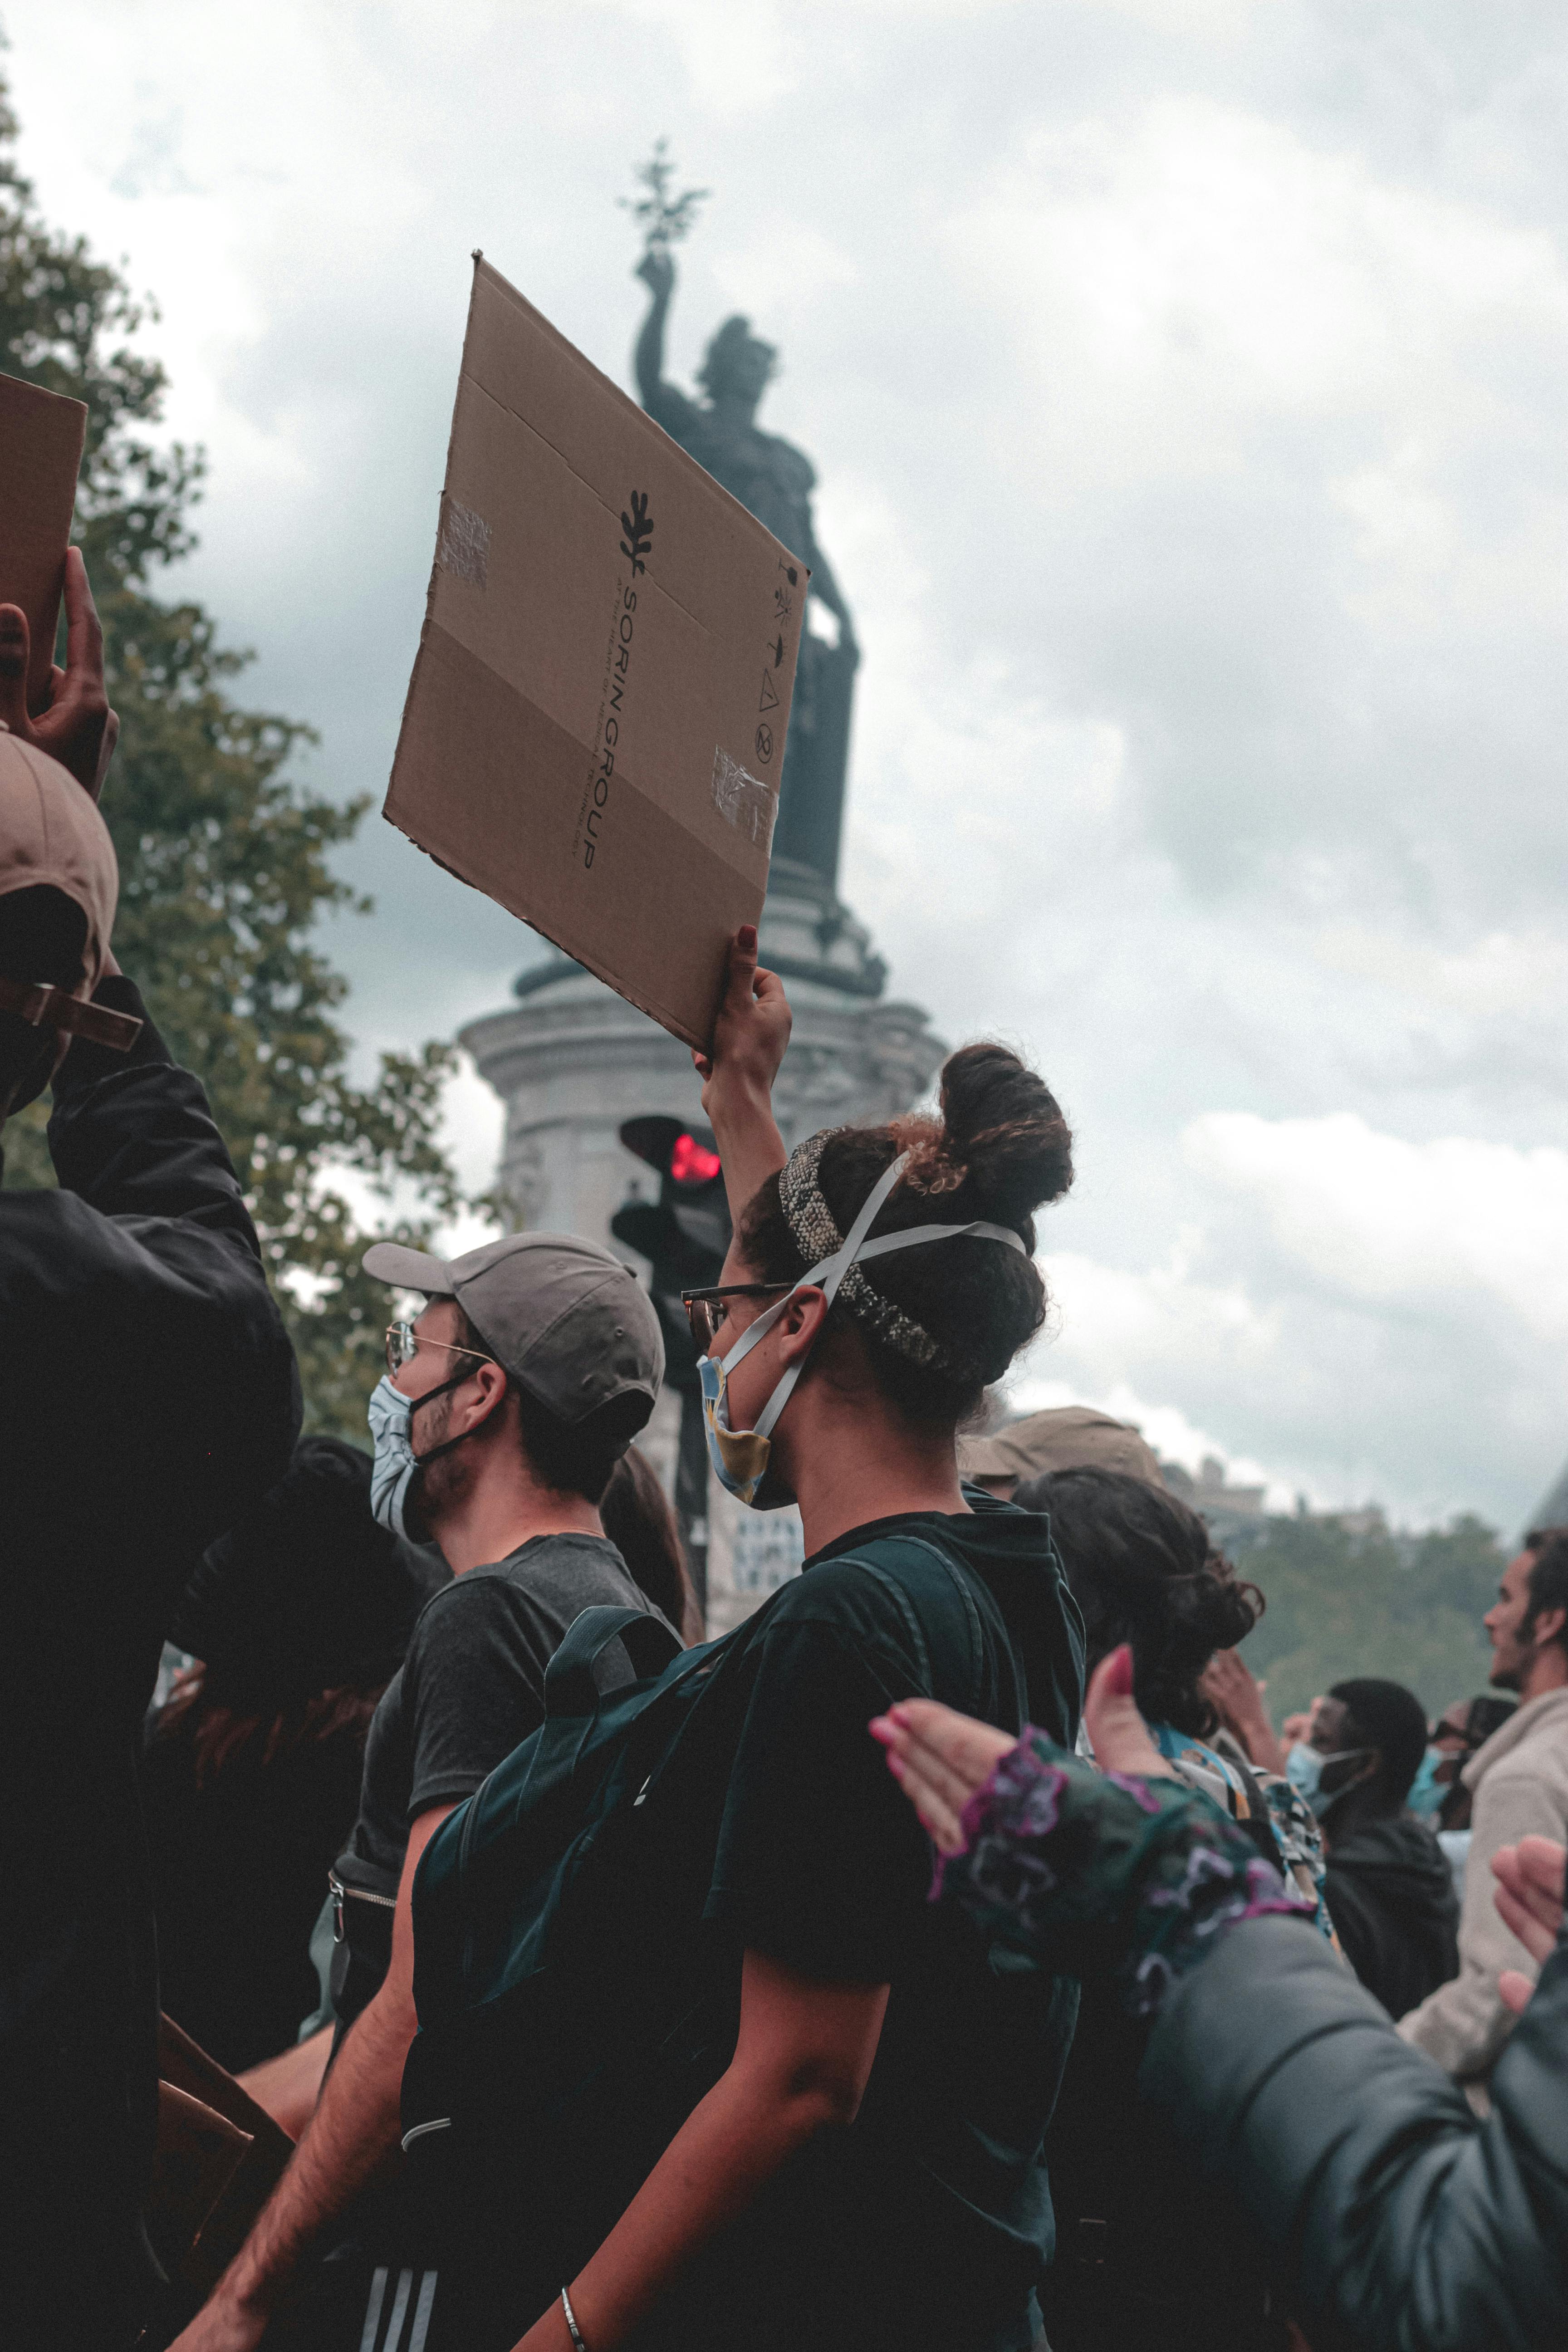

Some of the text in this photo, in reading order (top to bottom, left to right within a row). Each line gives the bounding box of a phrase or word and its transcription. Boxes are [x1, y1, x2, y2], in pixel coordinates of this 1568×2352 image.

[572, 577, 622, 859] AT THE HEART OF MEDICAL TECHNOLOGY
